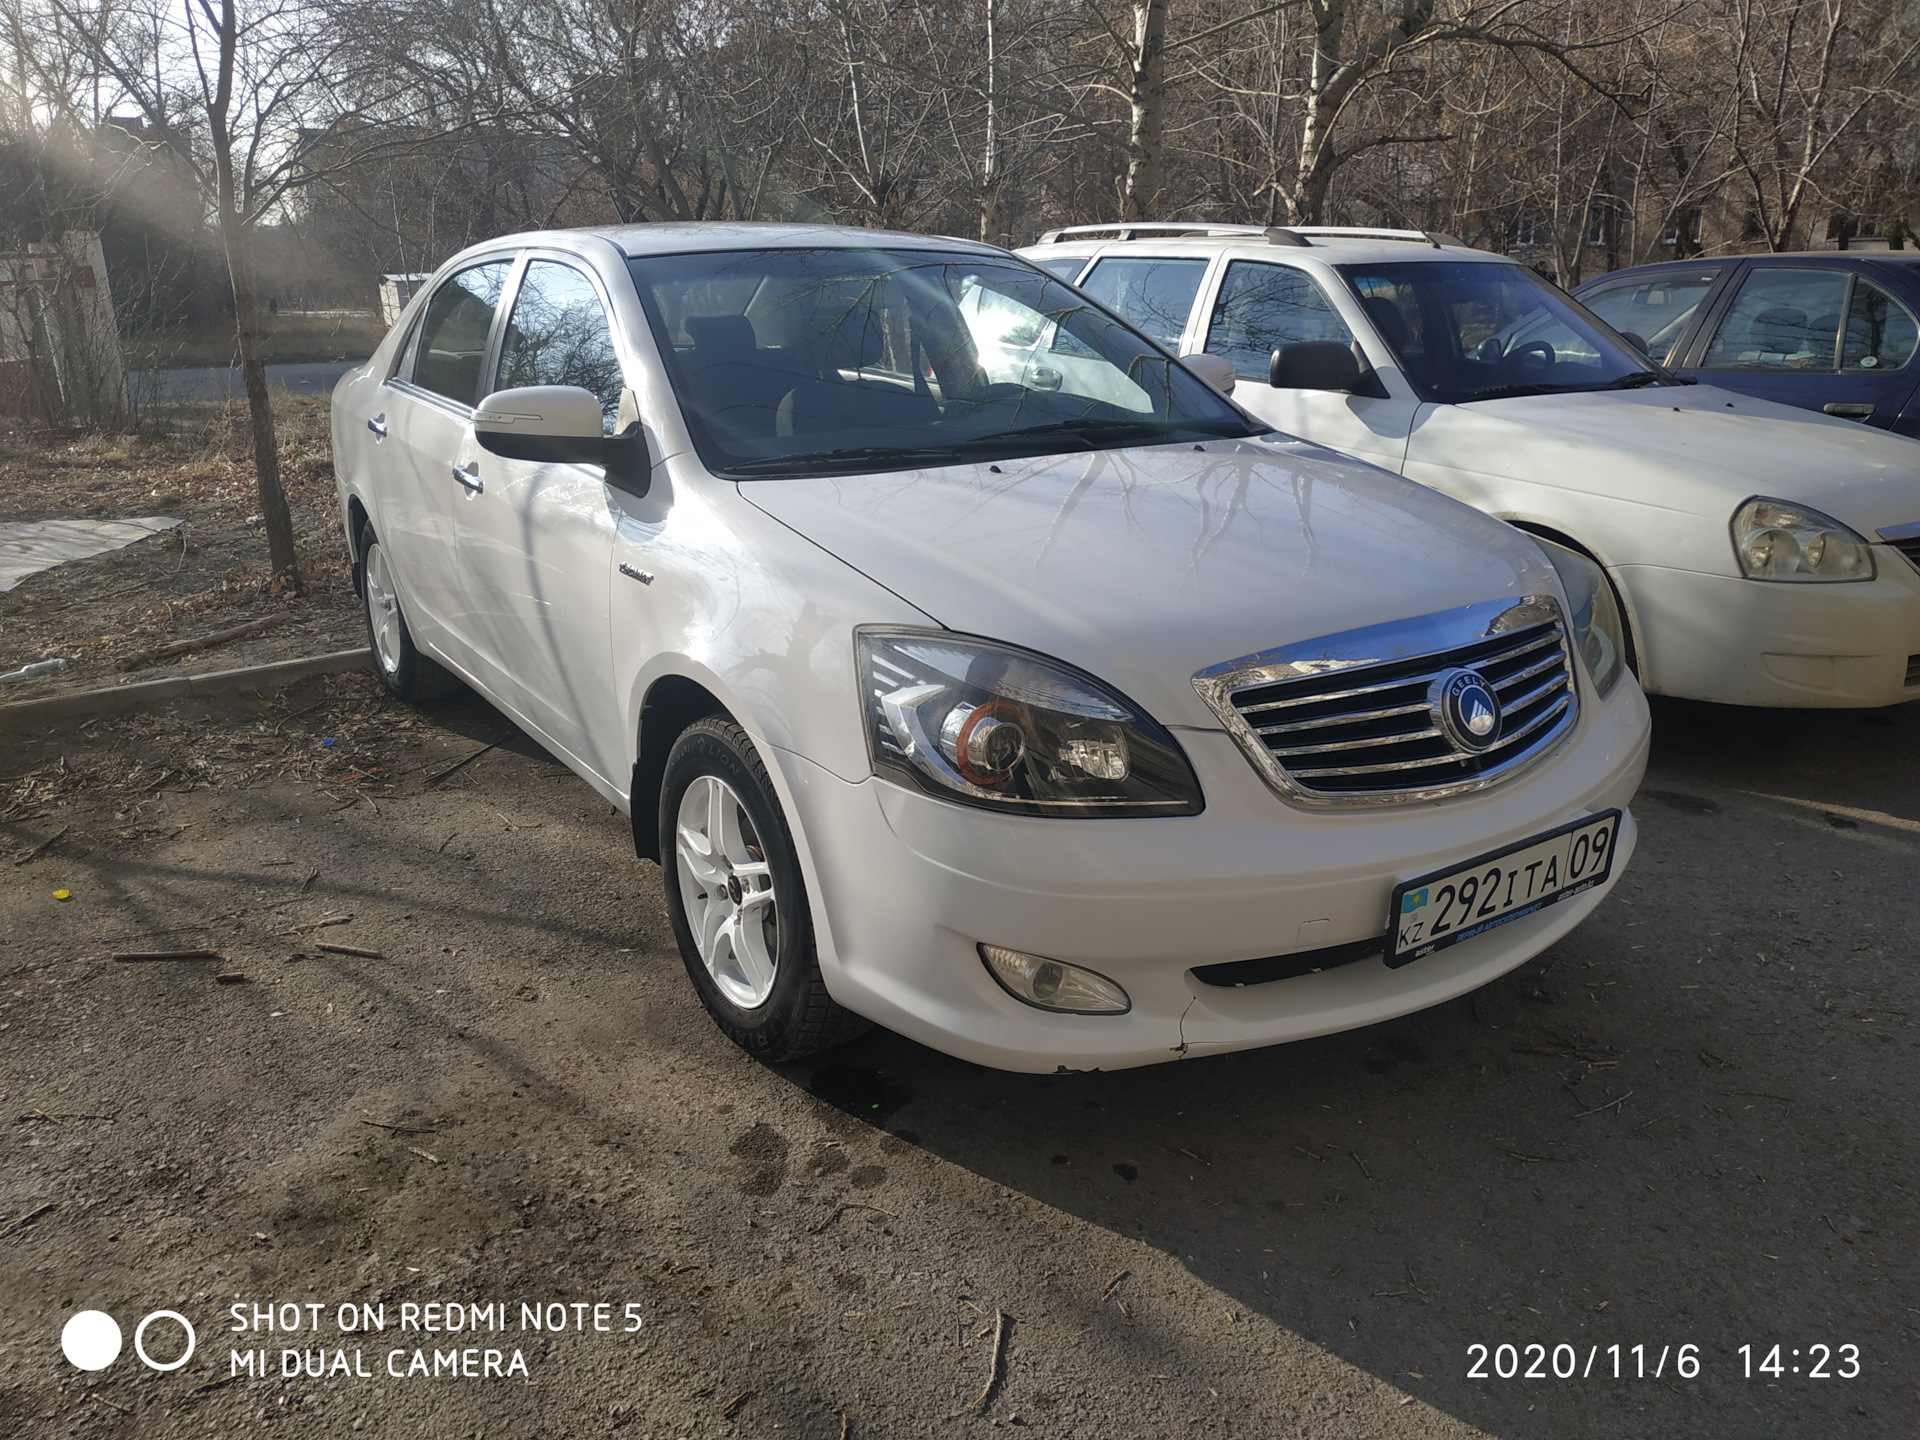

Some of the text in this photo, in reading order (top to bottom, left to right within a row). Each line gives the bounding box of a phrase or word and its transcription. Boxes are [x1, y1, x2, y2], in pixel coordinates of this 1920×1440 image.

[1451, 675, 1486, 697] GEELY
[708, 744, 740, 775] LION
[1569, 825, 1610, 880] 09
[1399, 921, 1424, 949] KZ
[1414, 943, 1436, 958] aster
